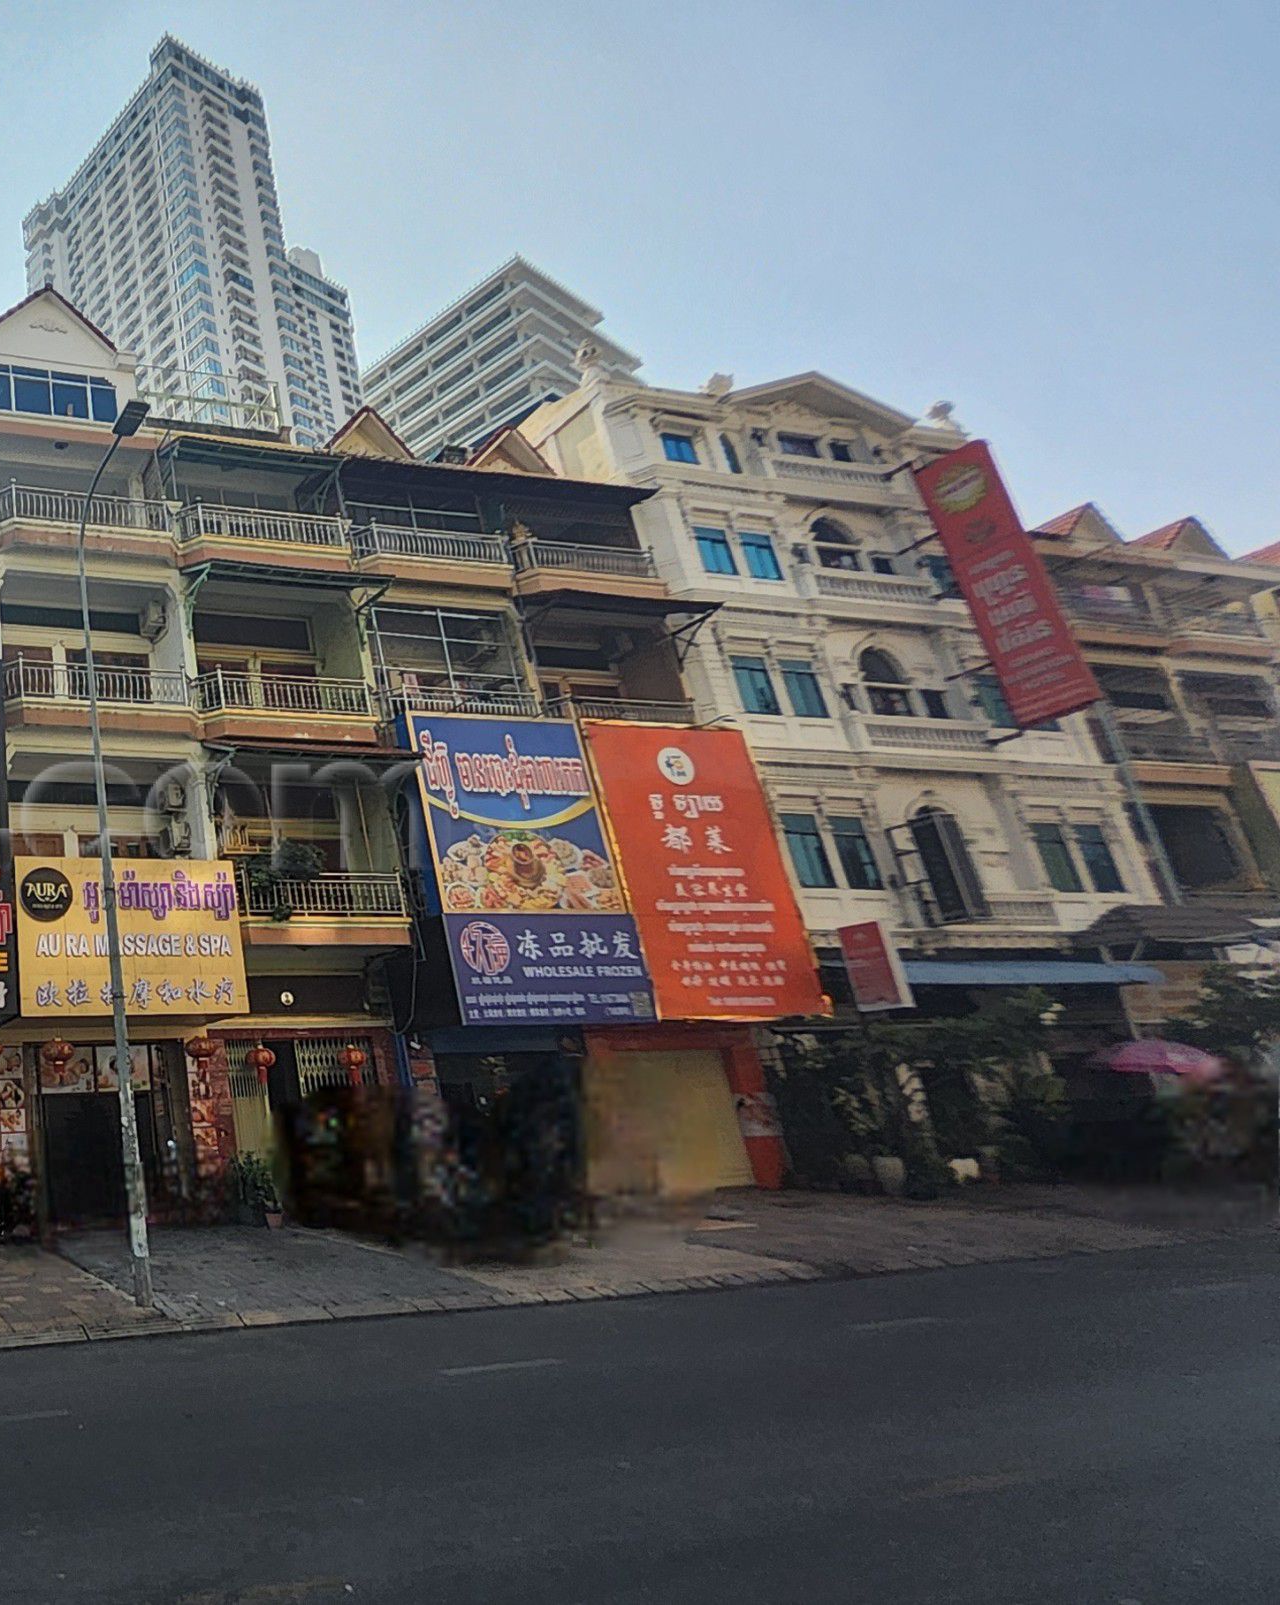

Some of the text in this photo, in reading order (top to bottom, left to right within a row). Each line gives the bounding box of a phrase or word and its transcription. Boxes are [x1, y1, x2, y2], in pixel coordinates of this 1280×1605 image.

[25, 882, 68, 902] AURA
[36, 933, 232, 957] AU RA MSSAGE & SPA
[516, 929, 639, 960] 冻品批发
[522, 965, 642, 978] WHOLESALE FROZEN
